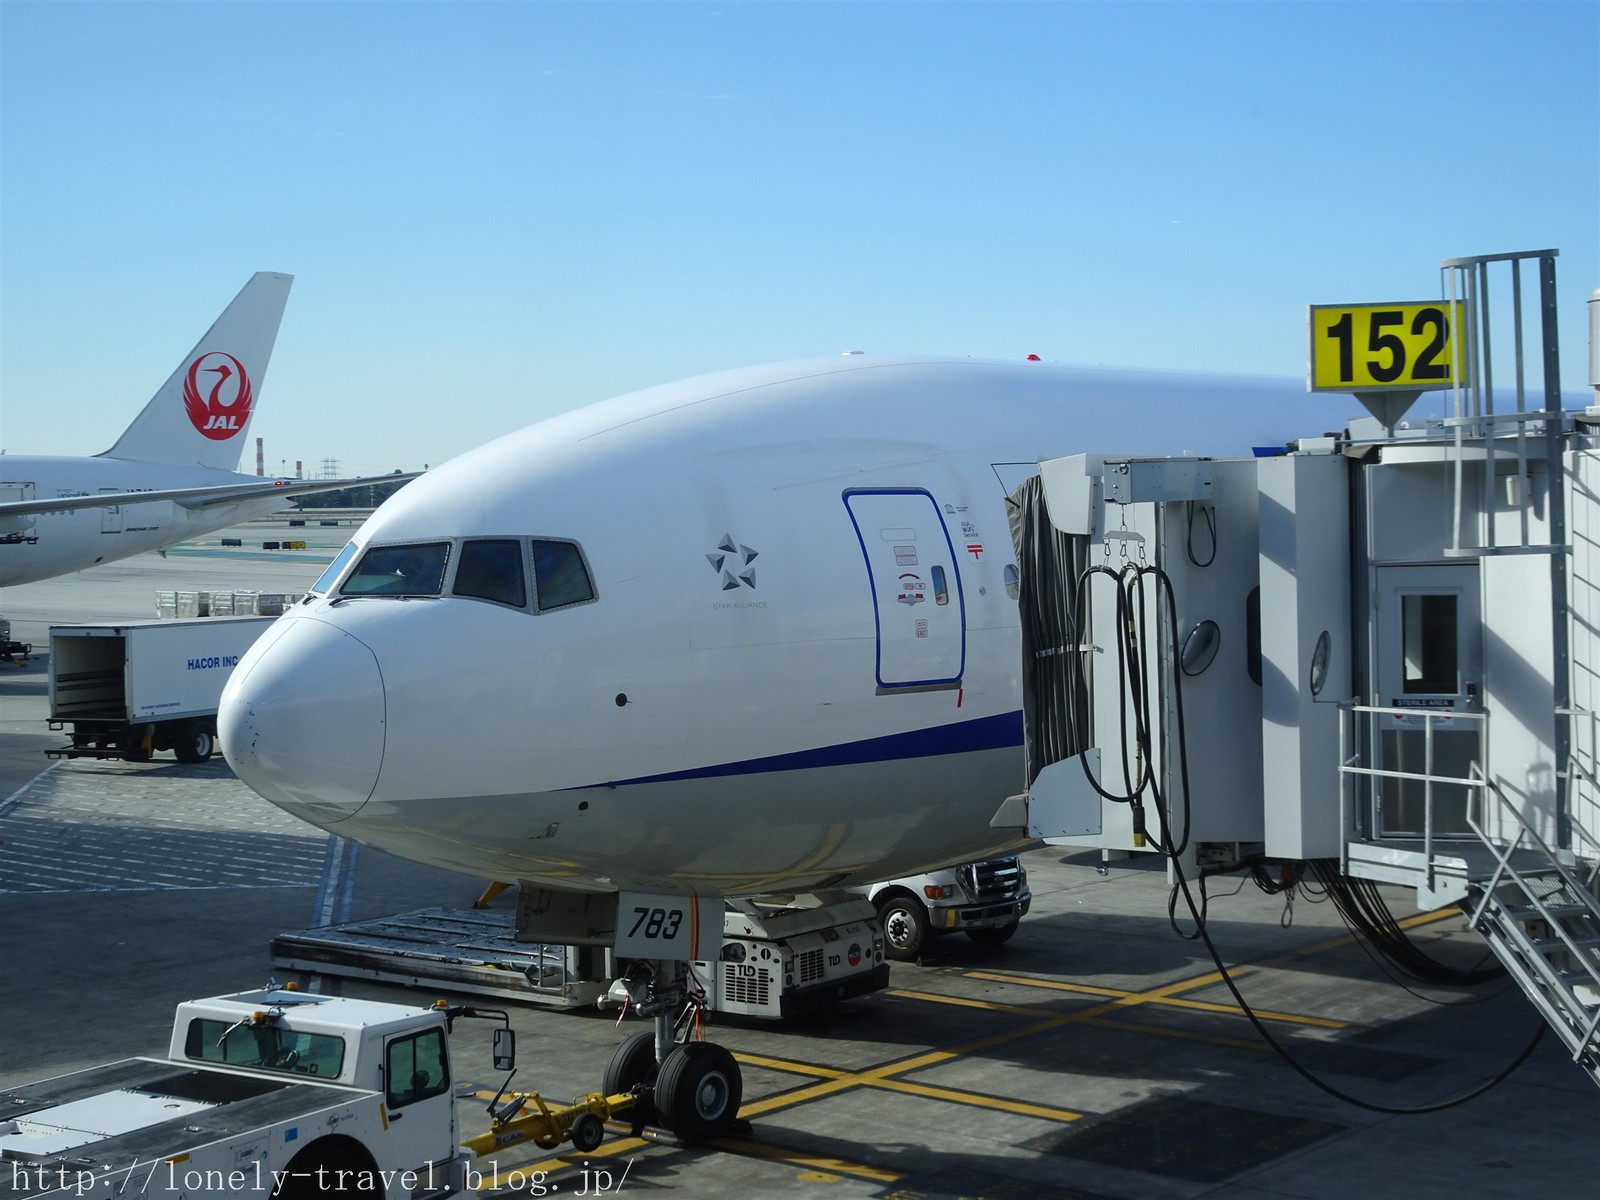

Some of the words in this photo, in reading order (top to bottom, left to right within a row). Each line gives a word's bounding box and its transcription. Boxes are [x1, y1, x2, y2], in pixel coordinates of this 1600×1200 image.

[1327, 307, 1450, 382] 152
[203, 415, 239, 430] JAL
[712, 601, 732, 610] STAR
[733, 601, 768, 609] ALLIANCE
[187, 657, 220, 670] HACOR
[222, 655, 239, 667] INC
[627, 906, 683, 940] 783
[828, 954, 841, 967] TLD
[737, 964, 756, 977] TLD
